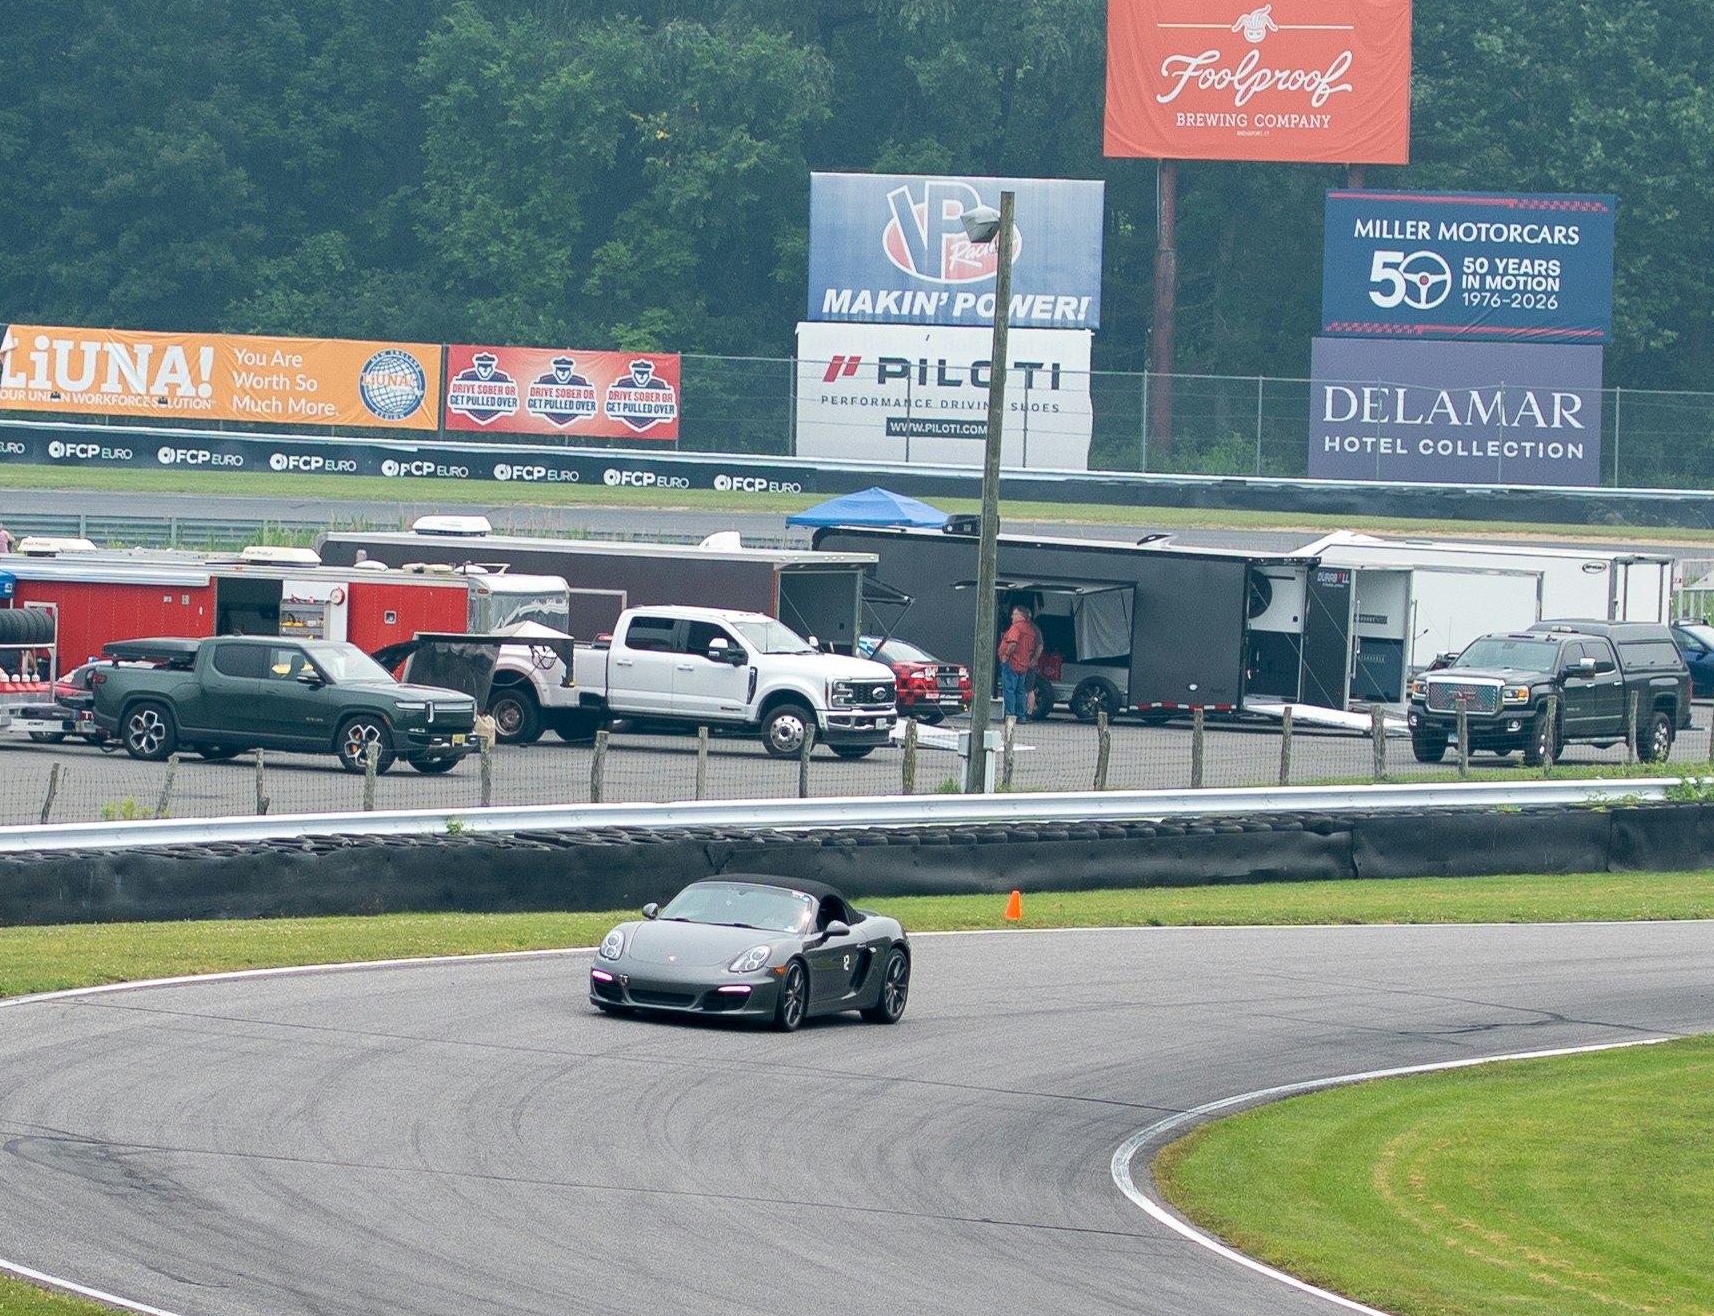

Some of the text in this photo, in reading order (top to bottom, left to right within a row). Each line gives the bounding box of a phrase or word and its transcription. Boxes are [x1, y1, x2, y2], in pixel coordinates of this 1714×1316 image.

[1155, 49, 1353, 108] Foolproof
[1176, 112, 1332, 129] BREWING COMPANY
[886, 180, 983, 281] VP
[1353, 218, 1581, 246] MILLER MOTORCARS
[1462, 257, 1561, 276] 50 YEARS
[1462, 274, 1561, 292] IN MOTION
[821, 288, 946, 317] MAKIN'
[1462, 291, 1559, 310] 1976-2026
[234, 348, 303, 368] You Are
[232, 370, 318, 392] Worth So
[452, 383, 516, 396] DRIVE SOBER OR
[0, 389, 26, 401] OUR
[72, 392, 150, 407] WORKFORCE
[450, 394, 518, 408] GET PULLED OVER
[530, 387, 595, 399] DRIVE SOBER OR
[608, 390, 673, 403] DRIVE SOBER OR
[232, 395, 340, 417] Much More.
[527, 398, 596, 411] GET PULLED OVER
[606, 401, 675, 414] GET PULLED OVER
[821, 395, 933, 409] PERFORMANCE
[940, 398, 990, 411] DRIVIN
[1323, 384, 1586, 429] DELAMAR
[65, 443, 133, 460] FCP EURO
[1324, 435, 1584, 459] HOTEL COLLECTION
[176, 449, 244, 467] FCP EURO
[288, 455, 357, 472] FCP EURO
[400, 461, 469, 478] FCP EURO
[512, 465, 580, 482] FCP EURO
[621, 471, 690, 489] FCP EURO
[732, 477, 802, 494] FCP EURO
